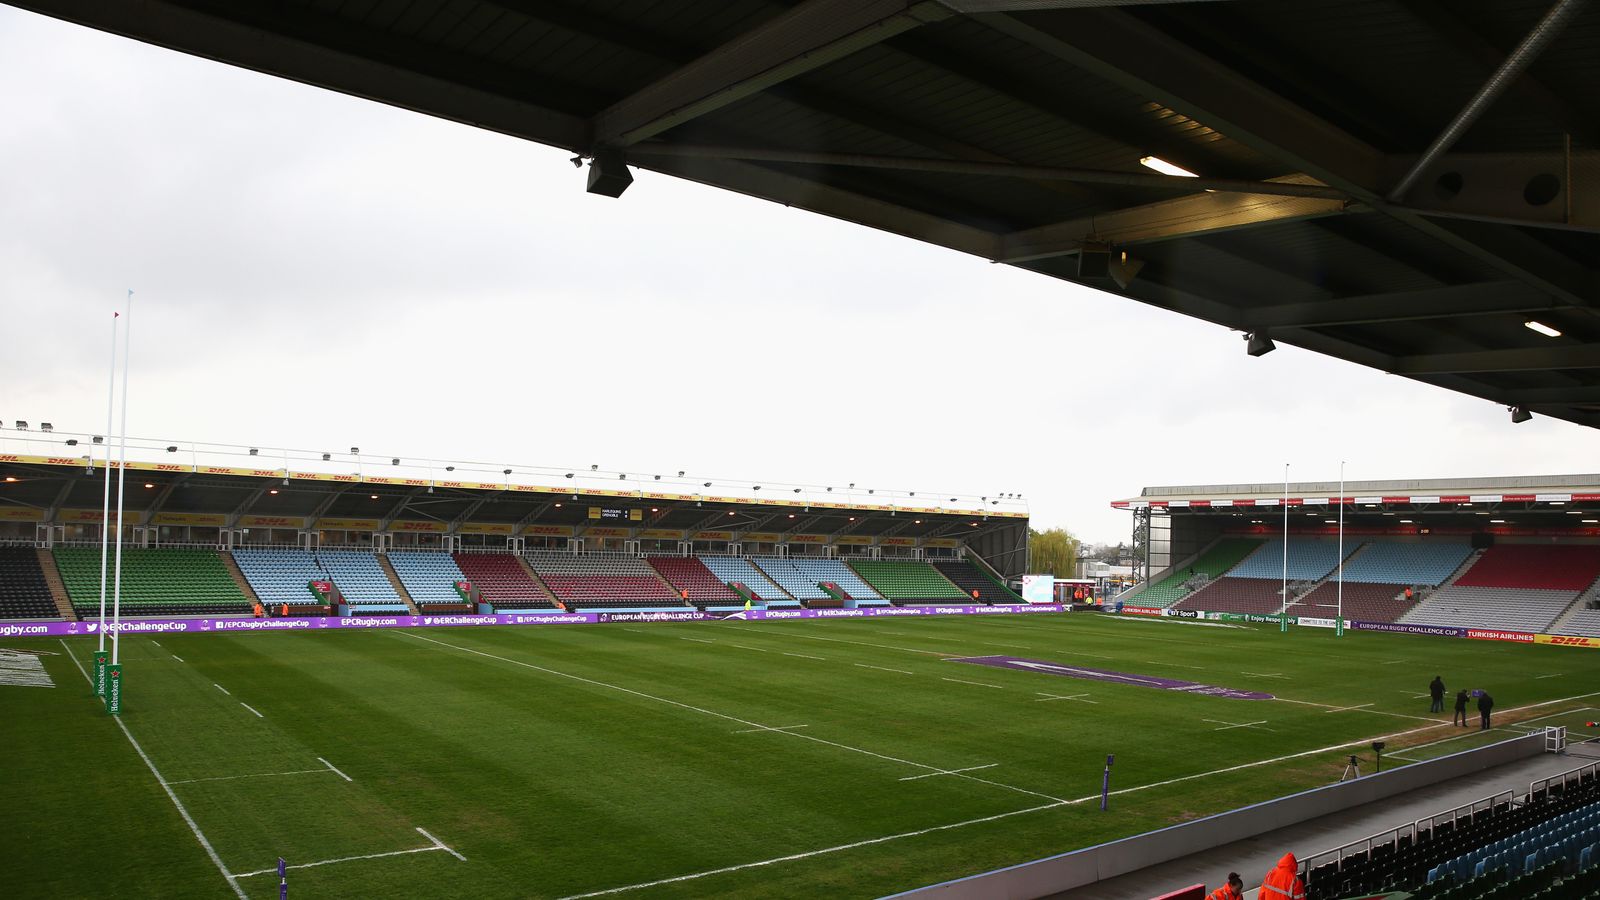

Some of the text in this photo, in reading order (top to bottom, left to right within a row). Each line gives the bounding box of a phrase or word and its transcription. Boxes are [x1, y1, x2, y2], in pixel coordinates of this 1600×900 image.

[434, 616, 497, 624] @ERChallengeCup
[611, 613, 642, 621] EUROPEAN
[1251, 615, 1296, 624] Enjoy Respobly
[341, 618, 397, 627] EPCRugby.com
[1409, 626, 1444, 635] CHALLENGE
[1468, 631, 1534, 641] TURKISH AIRLINES
[1551, 636, 1591, 646] DHL
[111, 679, 119, 711] Heineken
